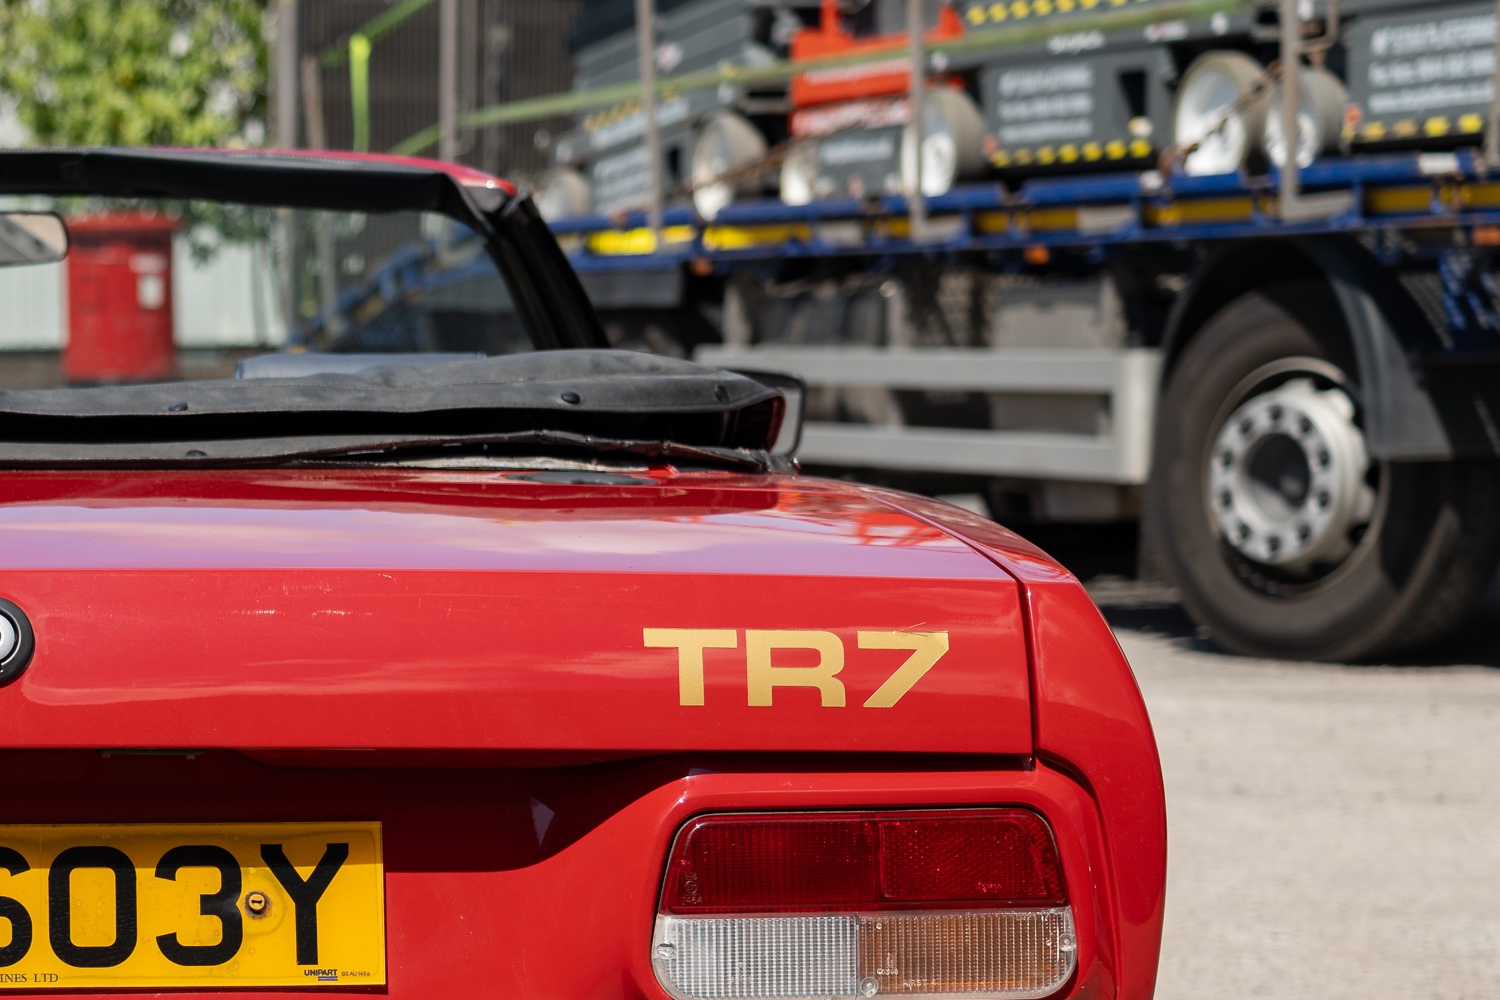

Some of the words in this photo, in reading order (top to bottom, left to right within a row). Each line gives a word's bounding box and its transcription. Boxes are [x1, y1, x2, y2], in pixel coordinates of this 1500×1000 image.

[642, 627, 950, 708] TR7
[303, 968, 338, 977] UNIPART
[33, 973, 60, 983] LTD
